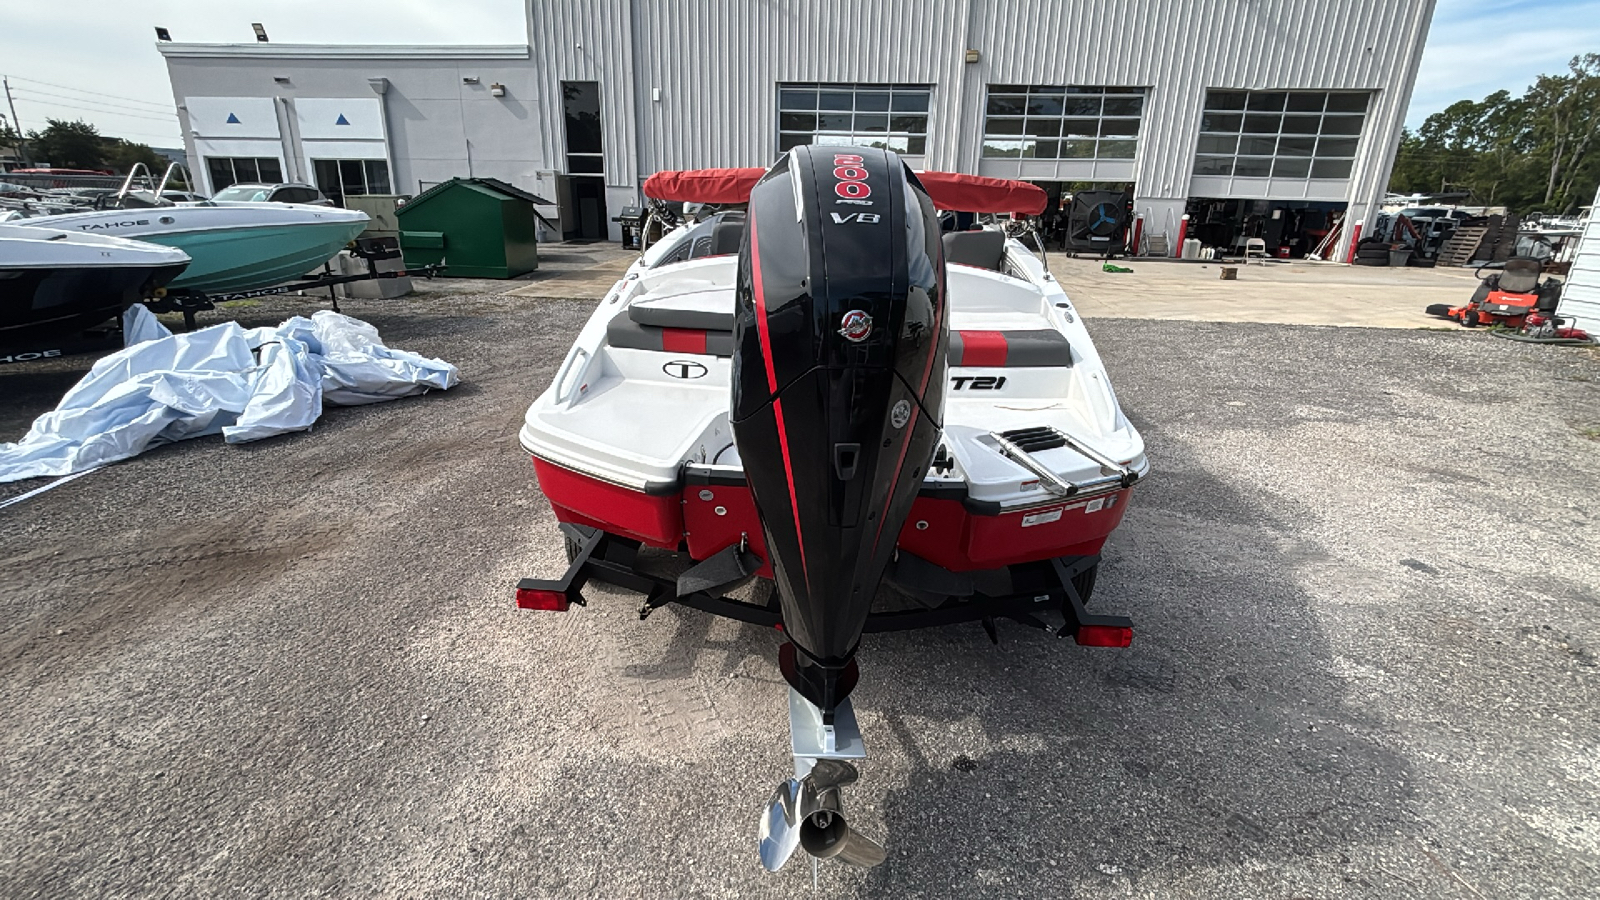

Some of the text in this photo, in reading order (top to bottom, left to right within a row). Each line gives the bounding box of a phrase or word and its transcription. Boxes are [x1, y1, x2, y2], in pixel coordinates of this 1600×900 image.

[833, 154, 872, 199] 200
[77, 219, 150, 231] TAHOE
[830, 212, 880, 224] V8
[218, 287, 289, 301] TAHOE
[950, 376, 1007, 391] T21
